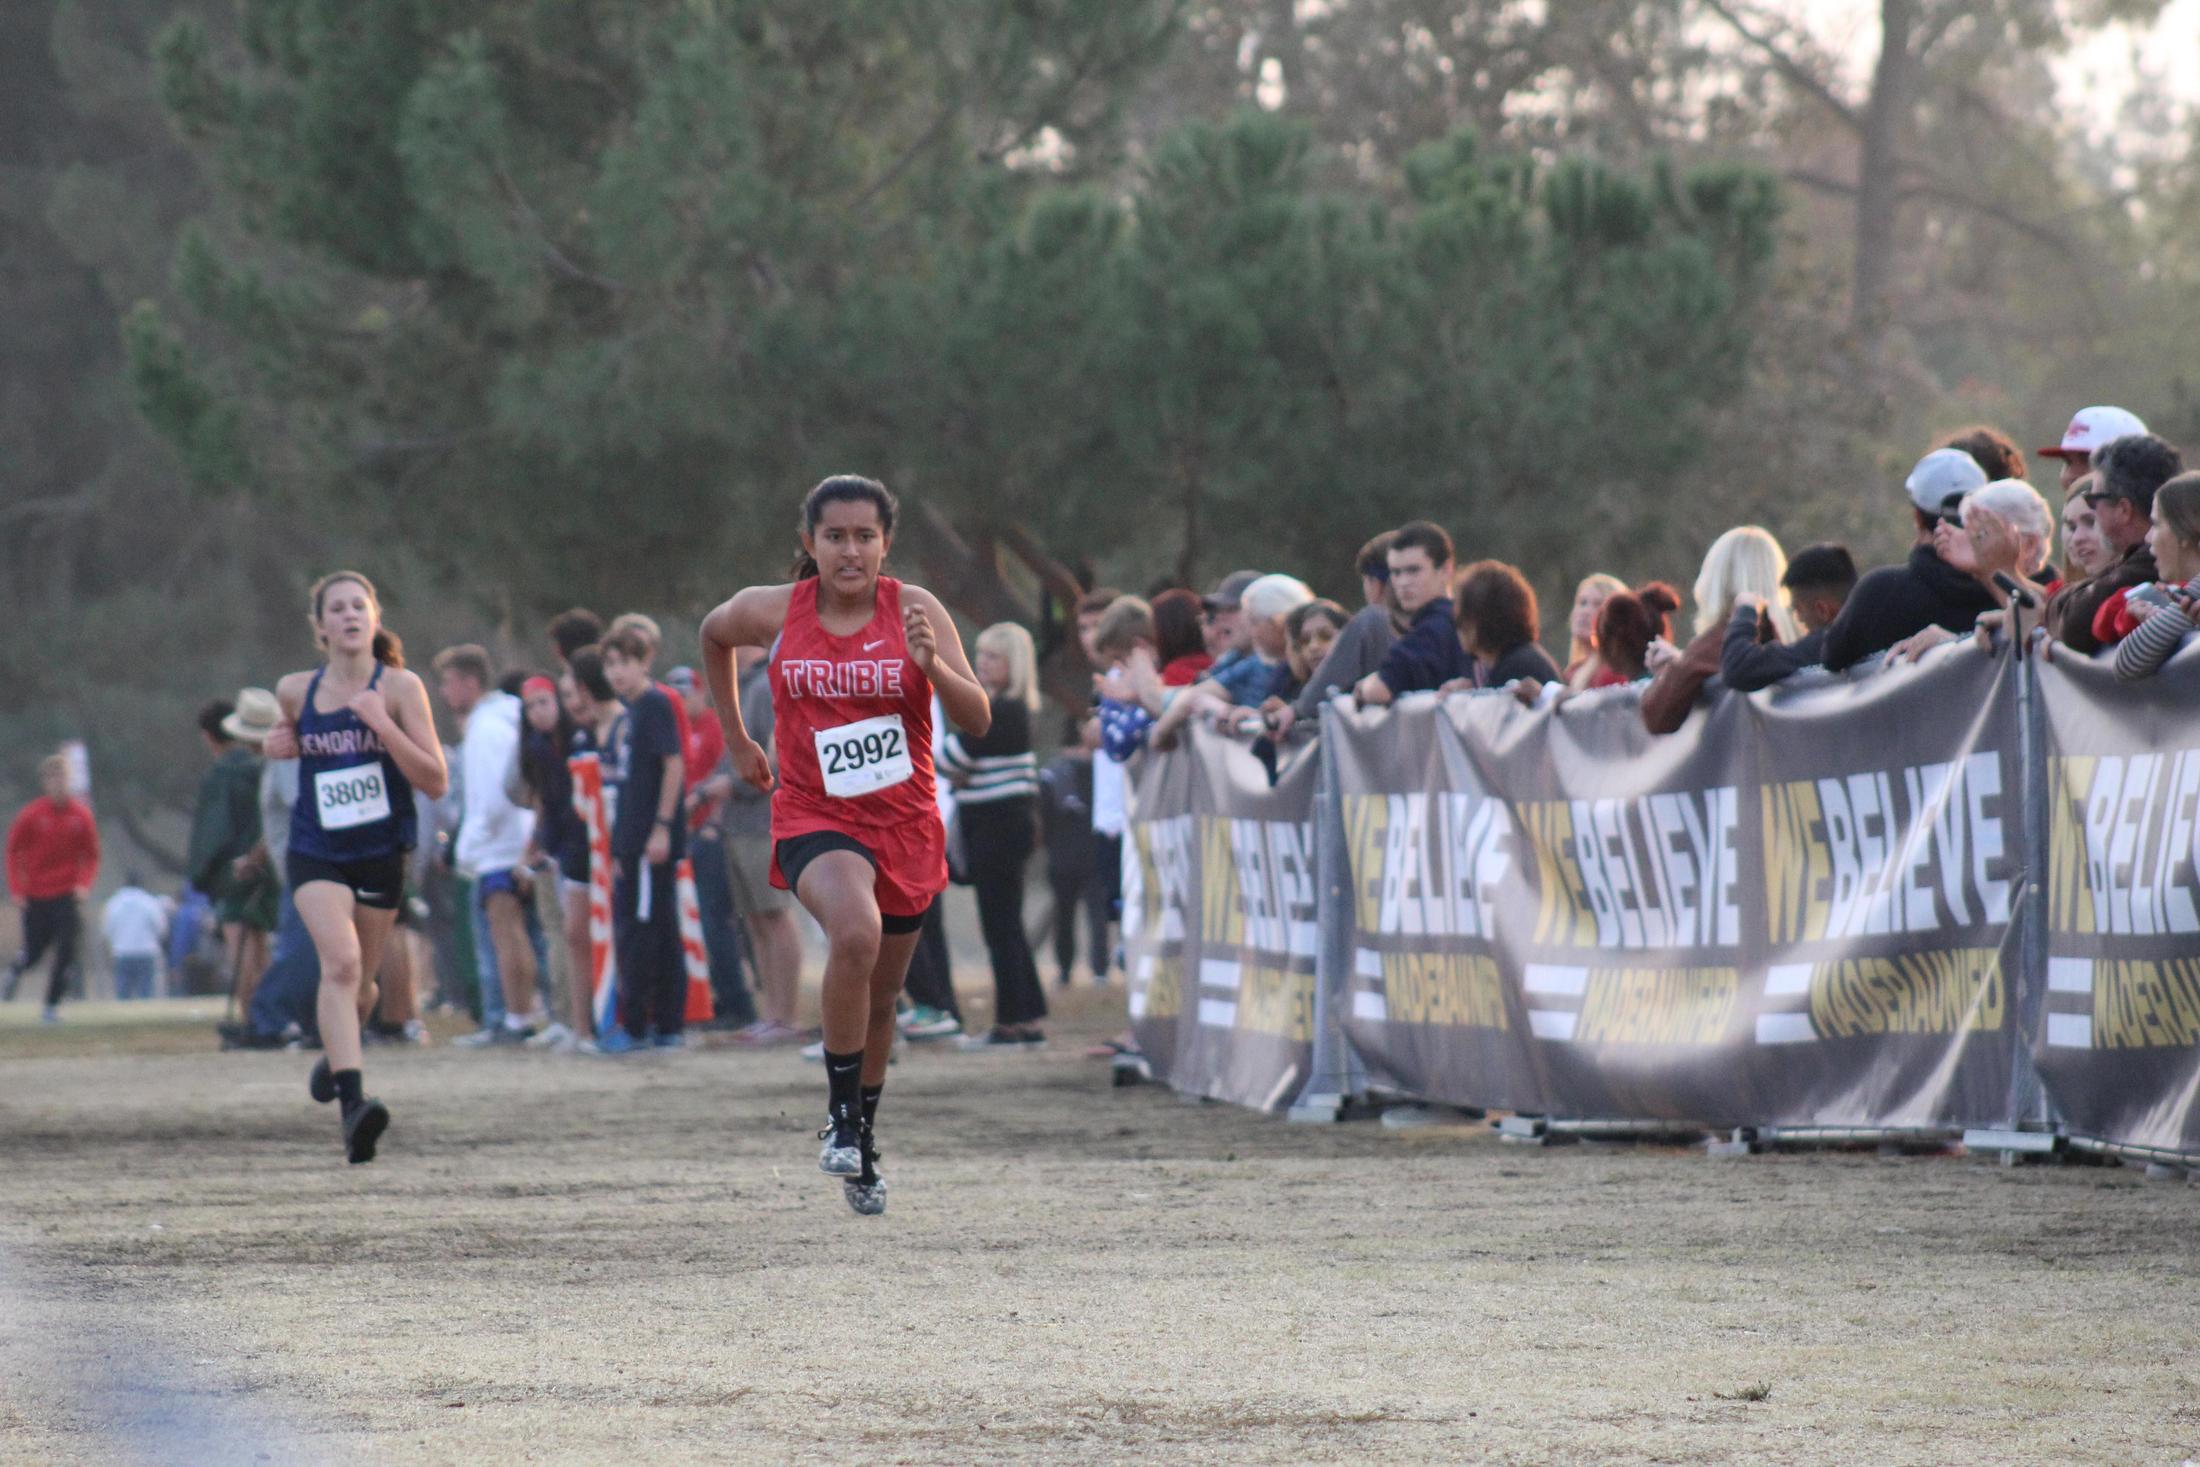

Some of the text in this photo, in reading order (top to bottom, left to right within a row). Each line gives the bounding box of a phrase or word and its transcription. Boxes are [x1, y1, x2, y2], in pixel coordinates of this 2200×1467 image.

[781, 659, 904, 698] TRIBE
[320, 774, 382, 808] 3809
[822, 727, 903, 775] 2992
[1570, 785, 1740, 948] BELIEVE
[1817, 750, 2011, 941] BELIEVE
[2085, 749, 2200, 936] BELIE
